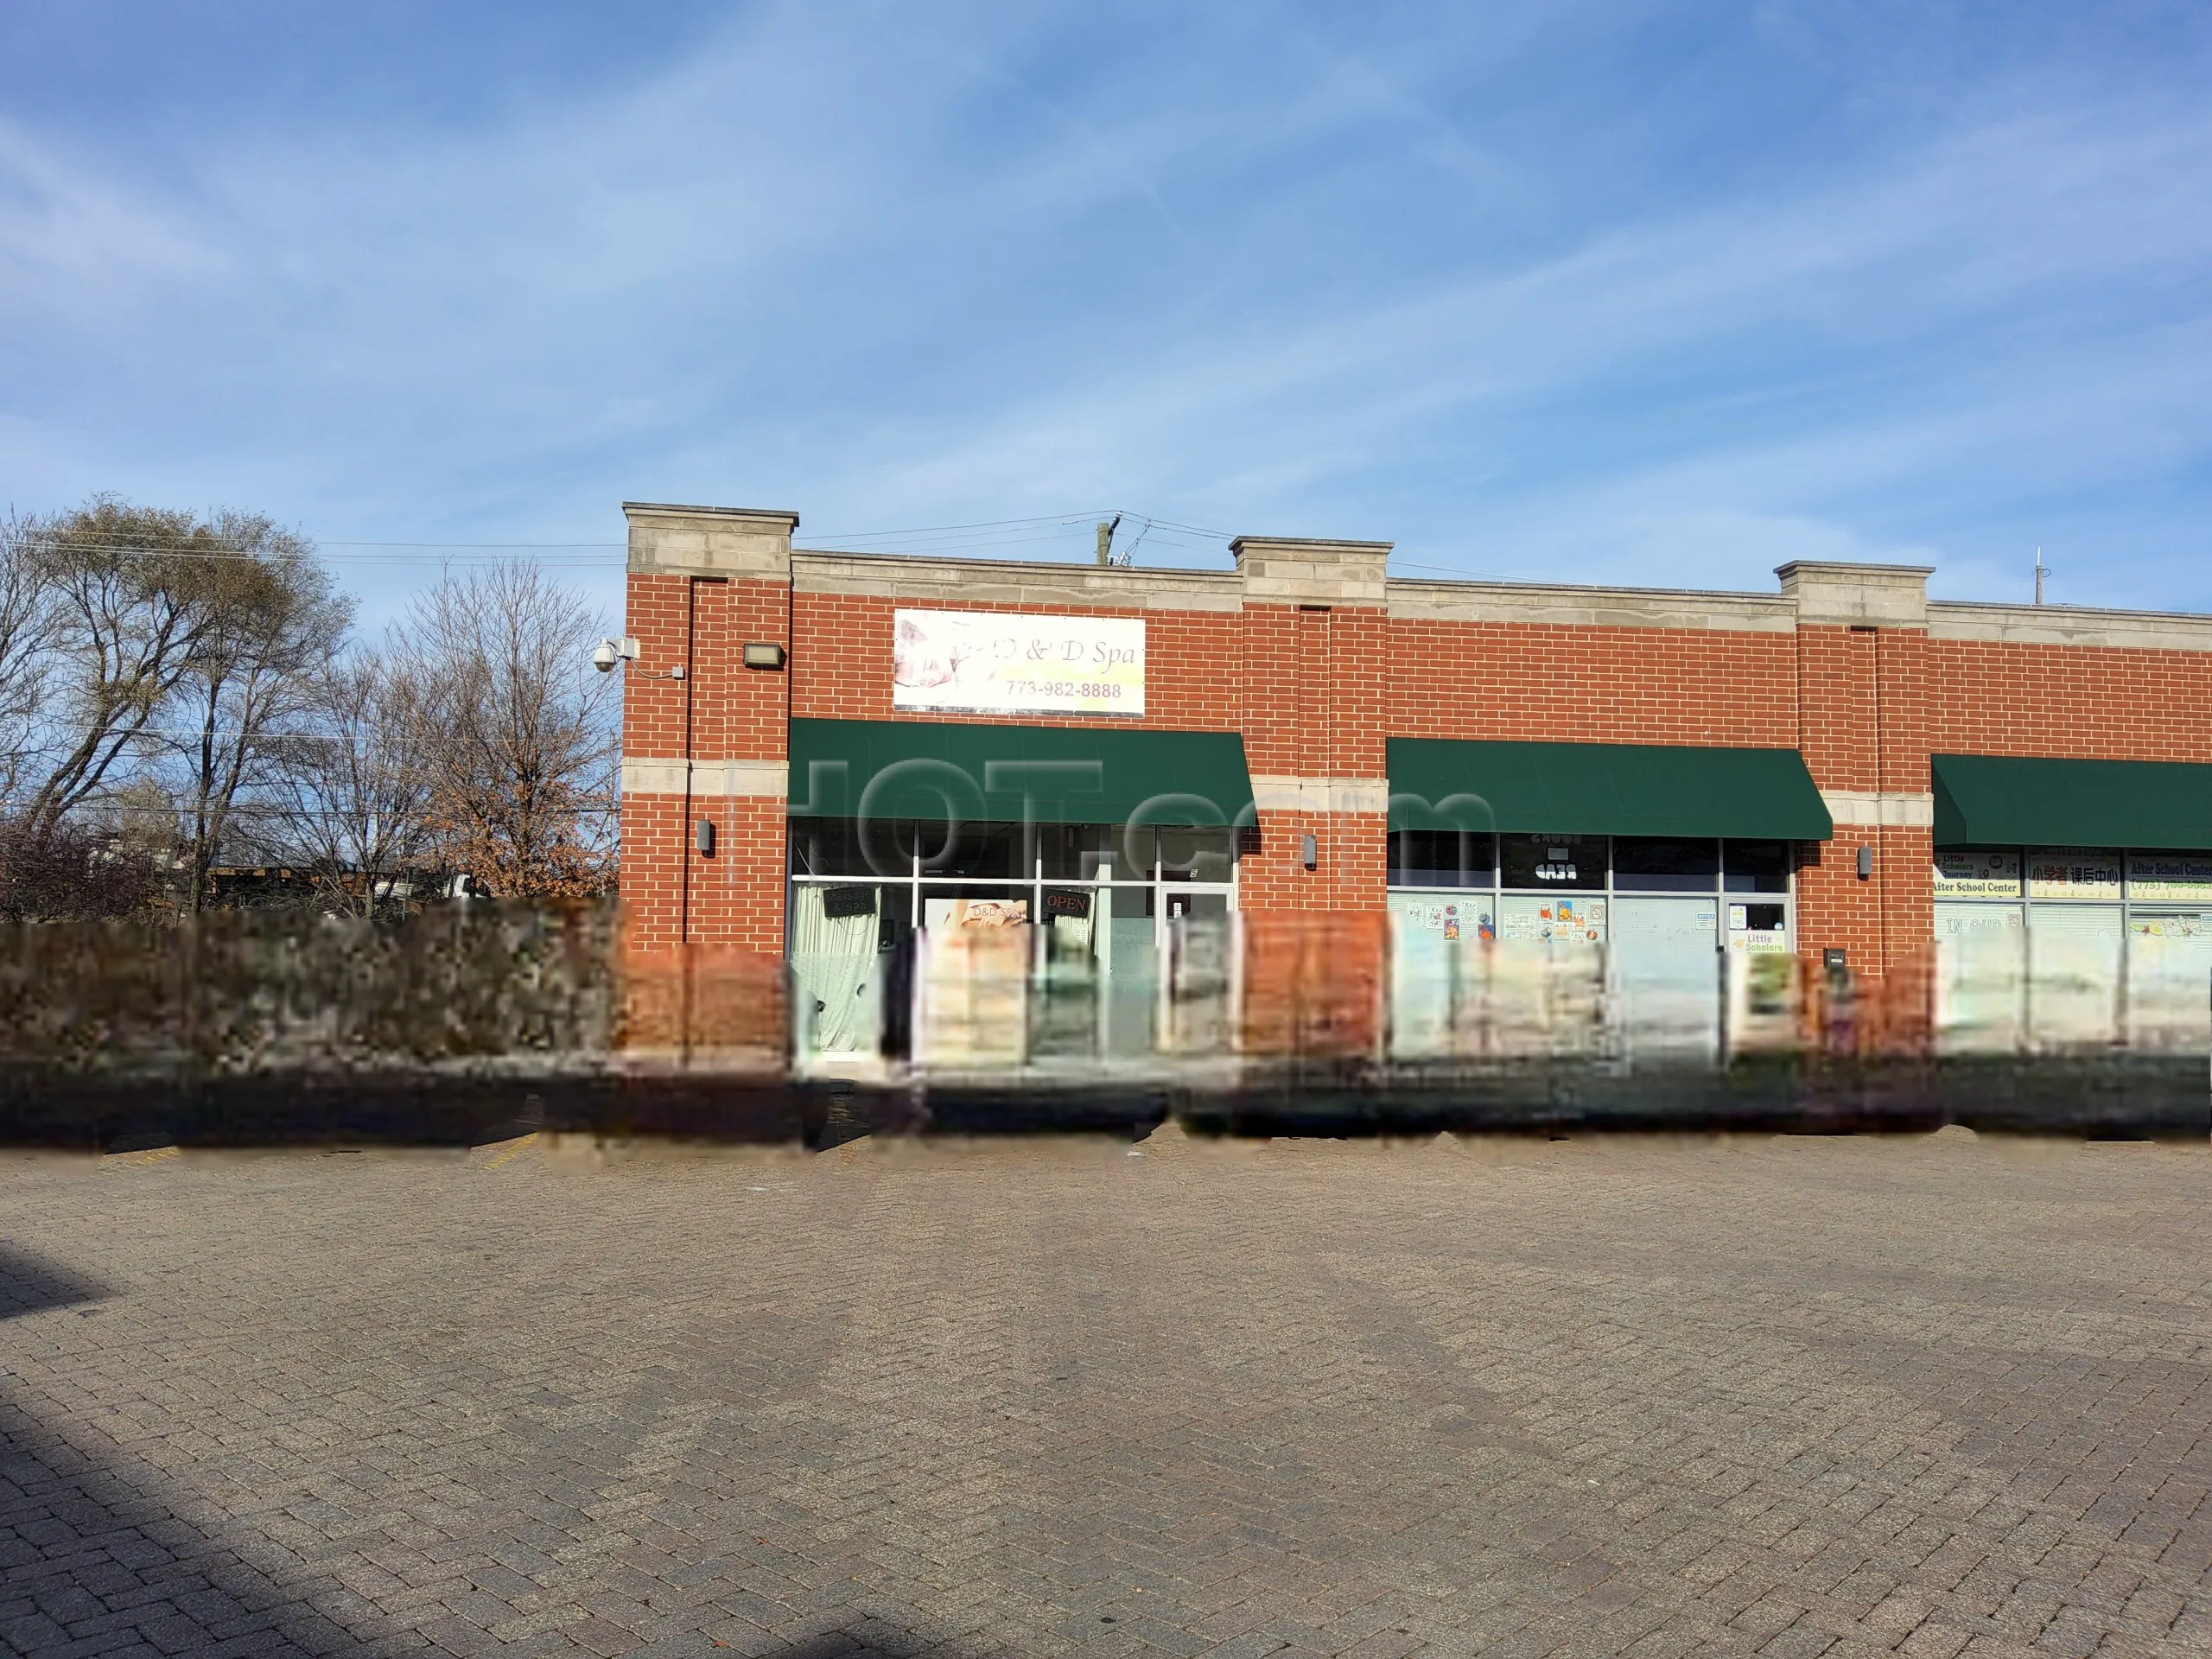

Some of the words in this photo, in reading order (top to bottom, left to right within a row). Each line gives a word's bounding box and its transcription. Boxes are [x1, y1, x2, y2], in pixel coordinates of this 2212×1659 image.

[1026, 639, 1052, 660] &
[1061, 640, 1084, 661] D
[1092, 641, 1135, 674] Spa
[1006, 680, 1122, 698] 773-982-8888
[2155, 862, 2183, 875] School
[1956, 882, 1986, 892] School
[1987, 882, 2017, 892] Center
[1047, 895, 1086, 911] OPEN
[1747, 934, 1772, 943] Little
[1745, 943, 1783, 951] Scholars
